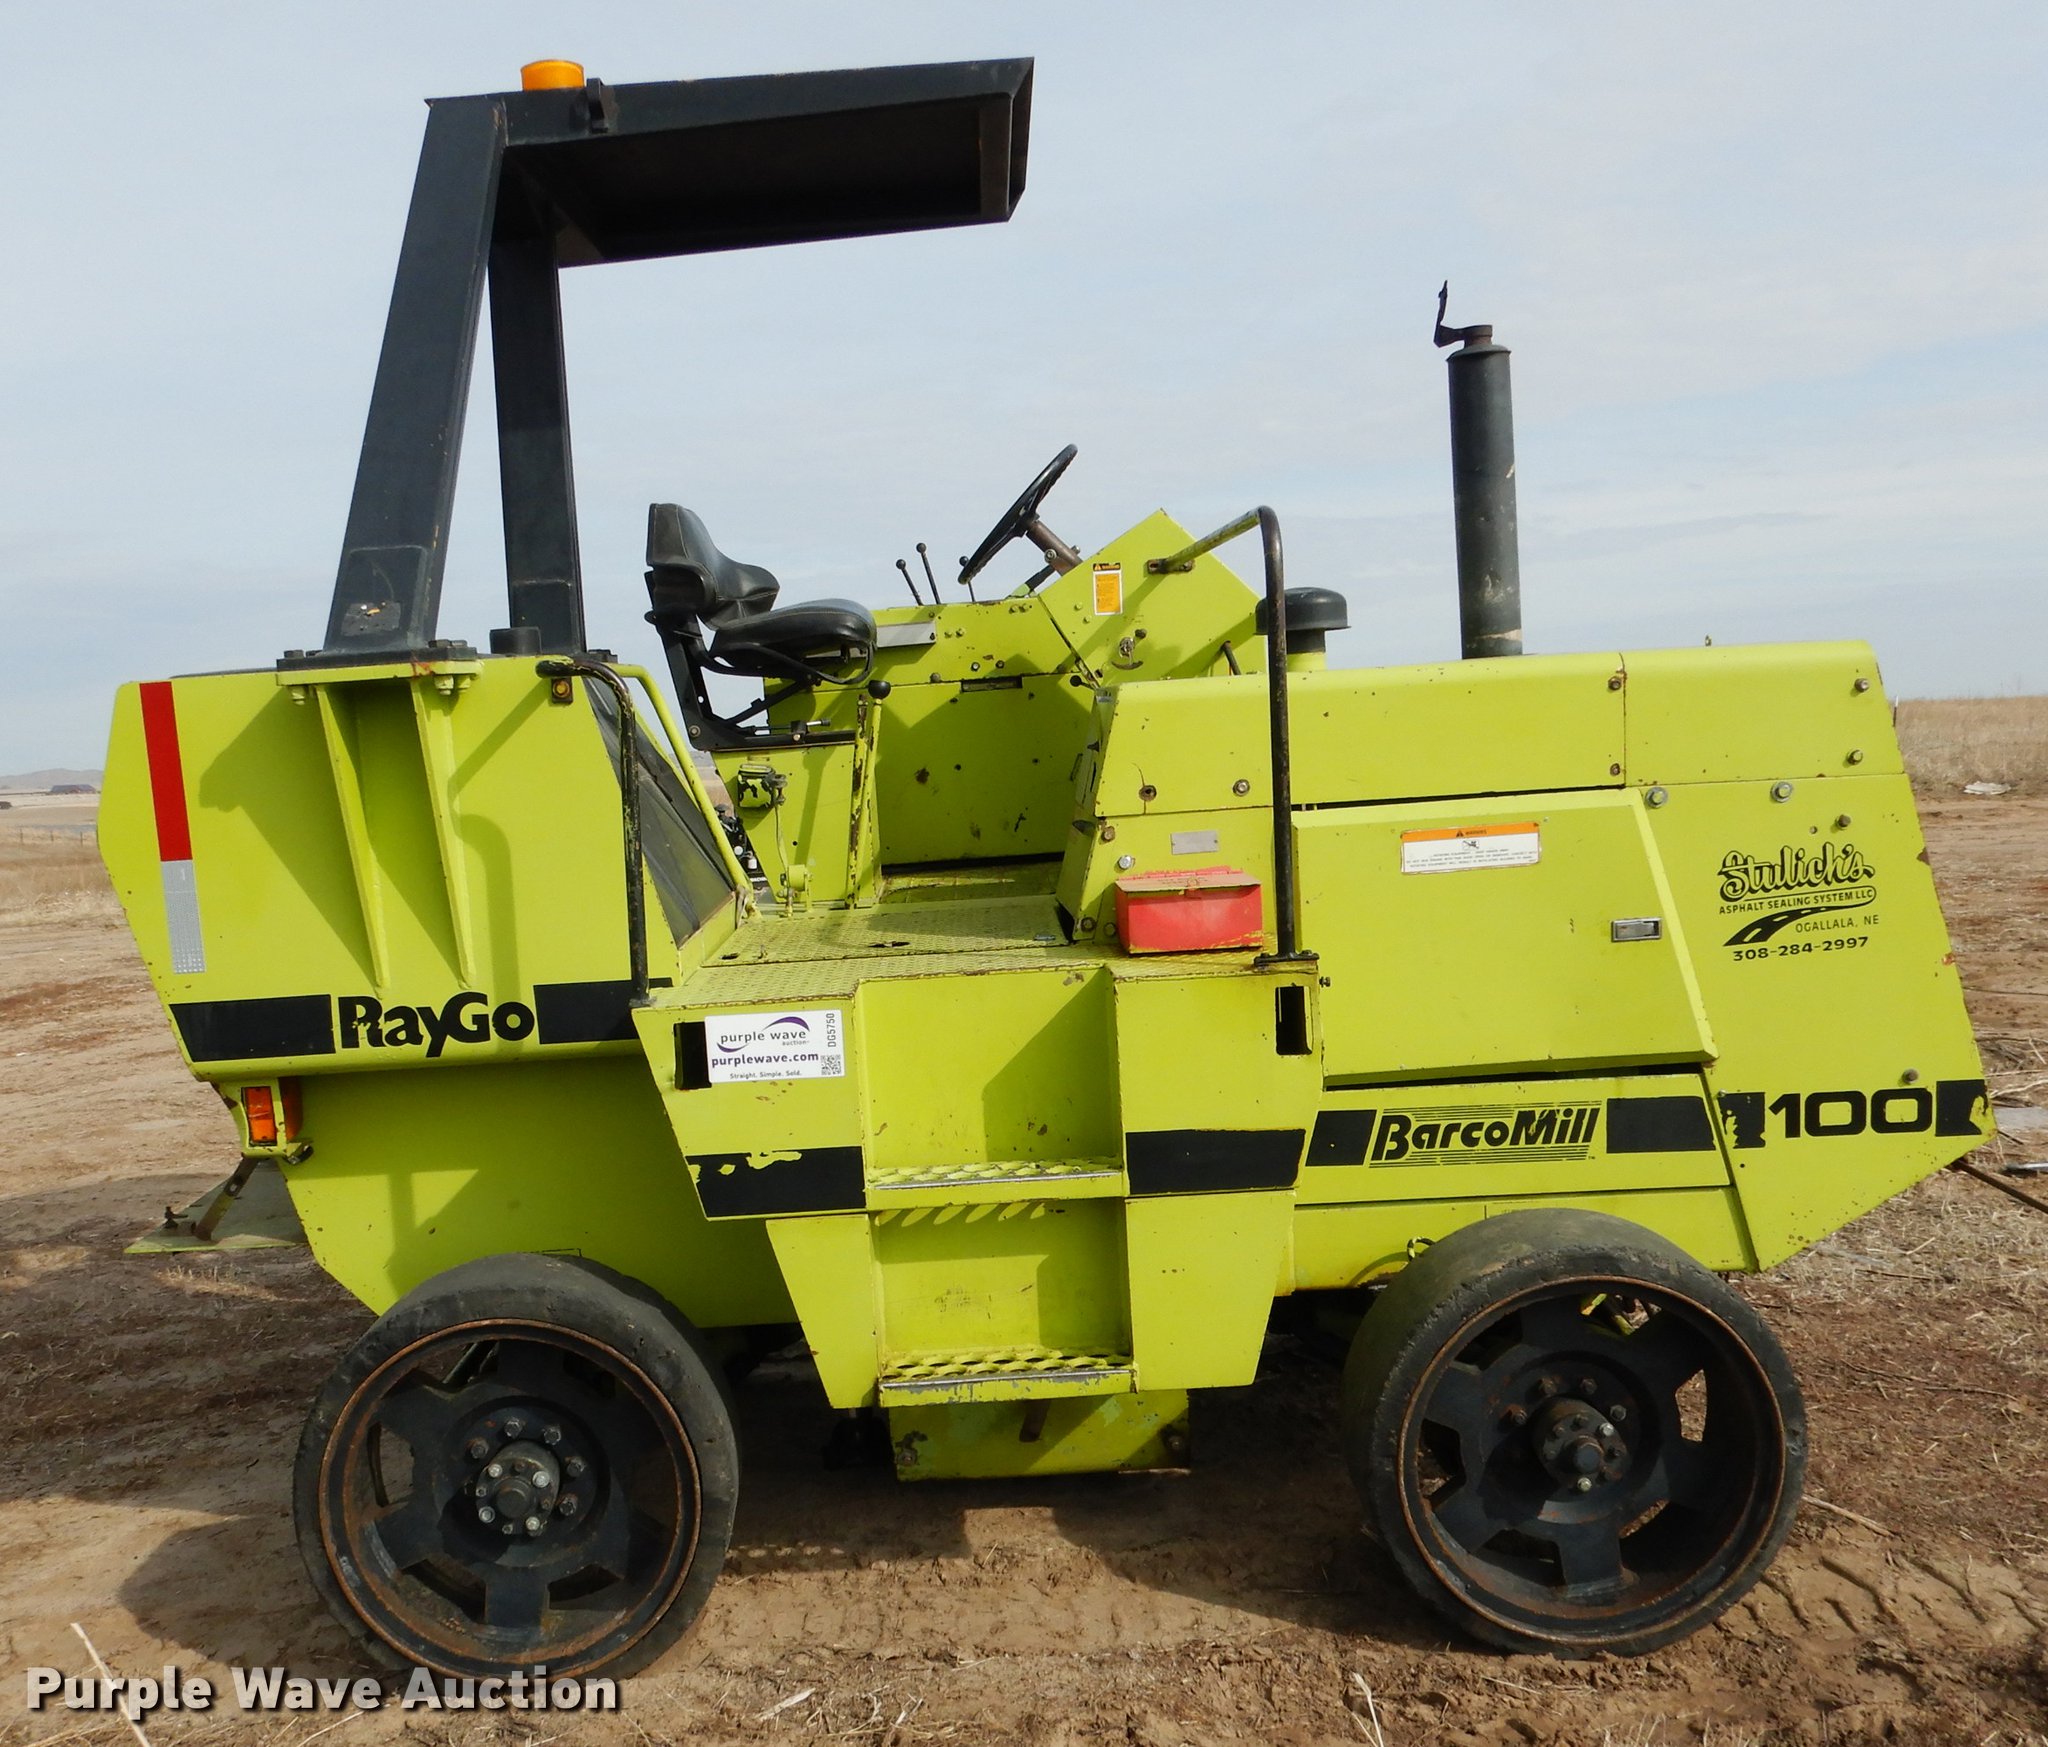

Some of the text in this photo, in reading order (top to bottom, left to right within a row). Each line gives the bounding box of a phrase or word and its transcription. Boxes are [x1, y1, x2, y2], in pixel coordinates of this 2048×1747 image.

[1717, 841, 1876, 902] Stulich's
[1719, 889, 1873, 915] ASPHALT SEALING SYSTEM LLC
[1864, 914, 1880, 926] NE
[1733, 936, 1869, 962] 308-284-2997
[337, 991, 535, 1058] RayGo
[720, 1030, 806, 1045] purple wave
[826, 1012, 837, 1048] DG5750
[711, 1052, 819, 1069] purplewave.com
[729, 1072, 757, 1080] Straight.
[759, 1071, 784, 1079] Simple.
[1769, 1088, 1933, 1138] 100
[1371, 1107, 1601, 1161] BarcoMill
